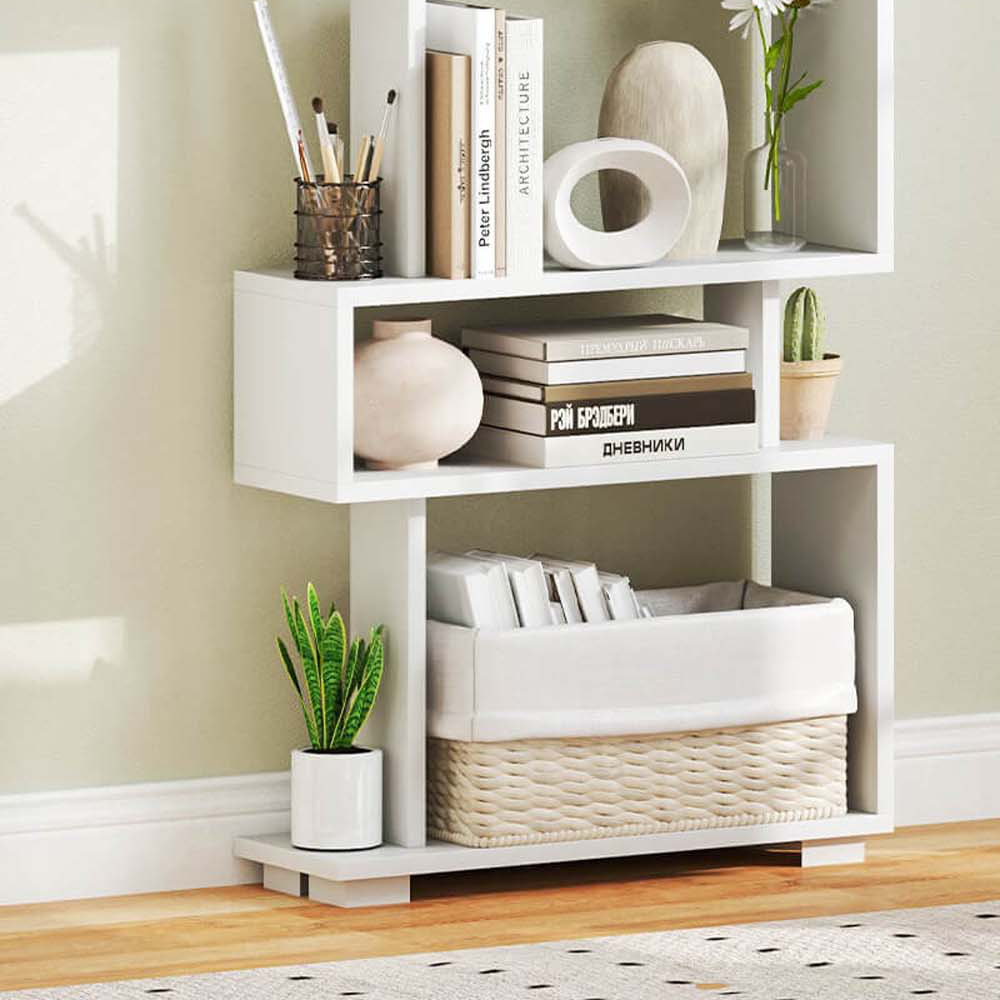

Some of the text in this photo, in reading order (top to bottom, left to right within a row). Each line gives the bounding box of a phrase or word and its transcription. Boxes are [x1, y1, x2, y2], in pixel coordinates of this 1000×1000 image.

[518, 71, 530, 195] ARCHITECTURE
[478, 129, 492, 247] Peter Lindbergh
[551, 403, 635, 431] РЭЙ БРЭДБЕРИ
[602, 437, 685, 458] ДНЕВНИКИ
